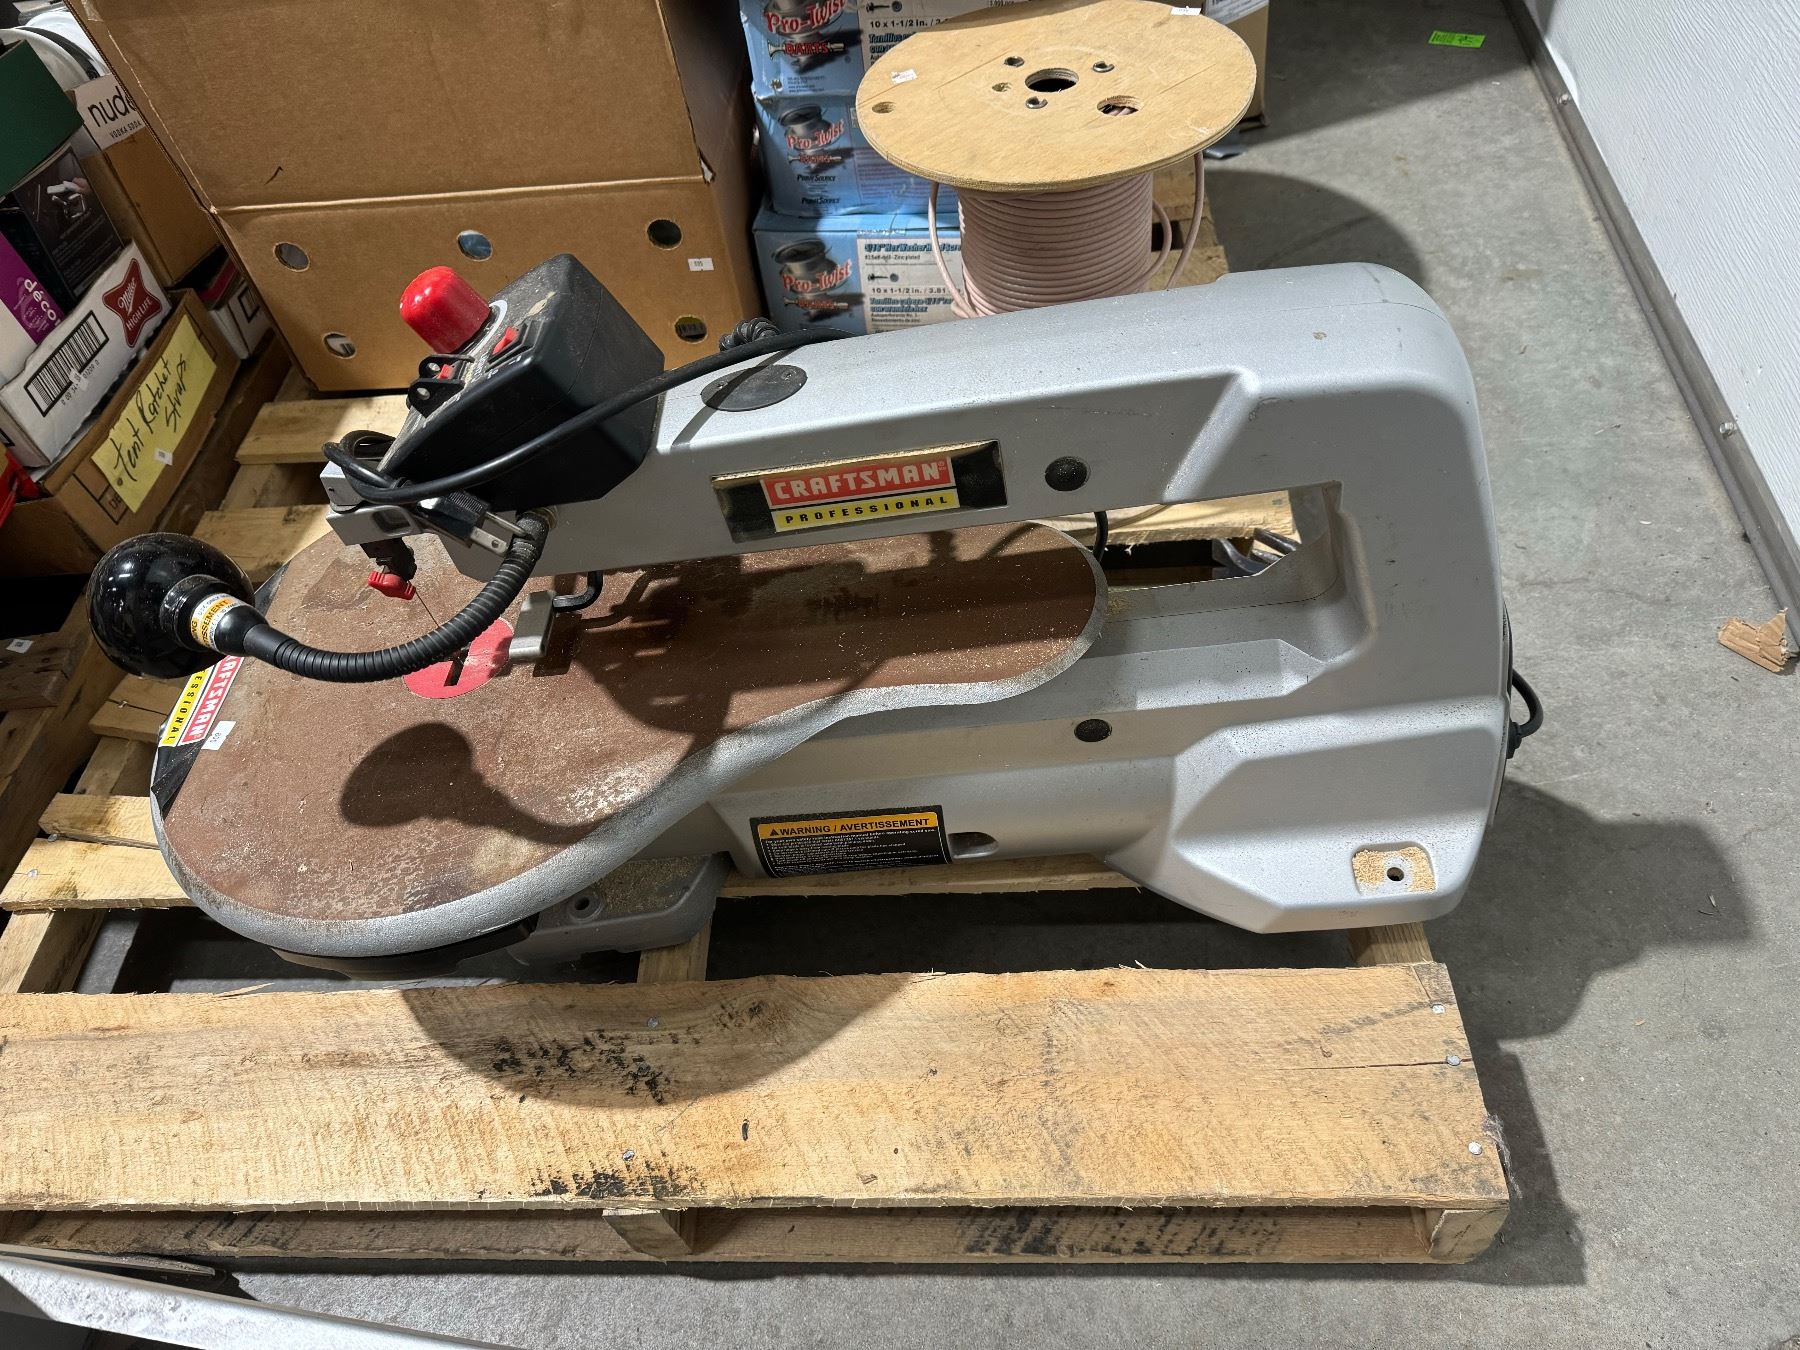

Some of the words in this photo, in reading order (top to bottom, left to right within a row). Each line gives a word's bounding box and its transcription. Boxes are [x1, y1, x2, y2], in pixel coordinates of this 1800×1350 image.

[891, 19, 914, 28] 1-1/2
[109, 126, 128, 139] VODKA
[787, 119, 844, 149] Pro-Twist
[782, 259, 852, 292] Pro-Twist
[117, 276, 138, 317] Miller
[125, 306, 142, 331] HIGH
[140, 296, 153, 316] LIFE
[774, 464, 938, 499] CRAFTSMAN
[785, 497, 948, 524] PROFESSIONAL
[201, 599, 230, 647] TISSEMENT
[167, 670, 206, 740] ESSIONAL
[190, 656, 238, 737] AFTSMAN
[779, 823, 831, 836] WARNING
[840, 818, 930, 832] AVERTISSEMENT
